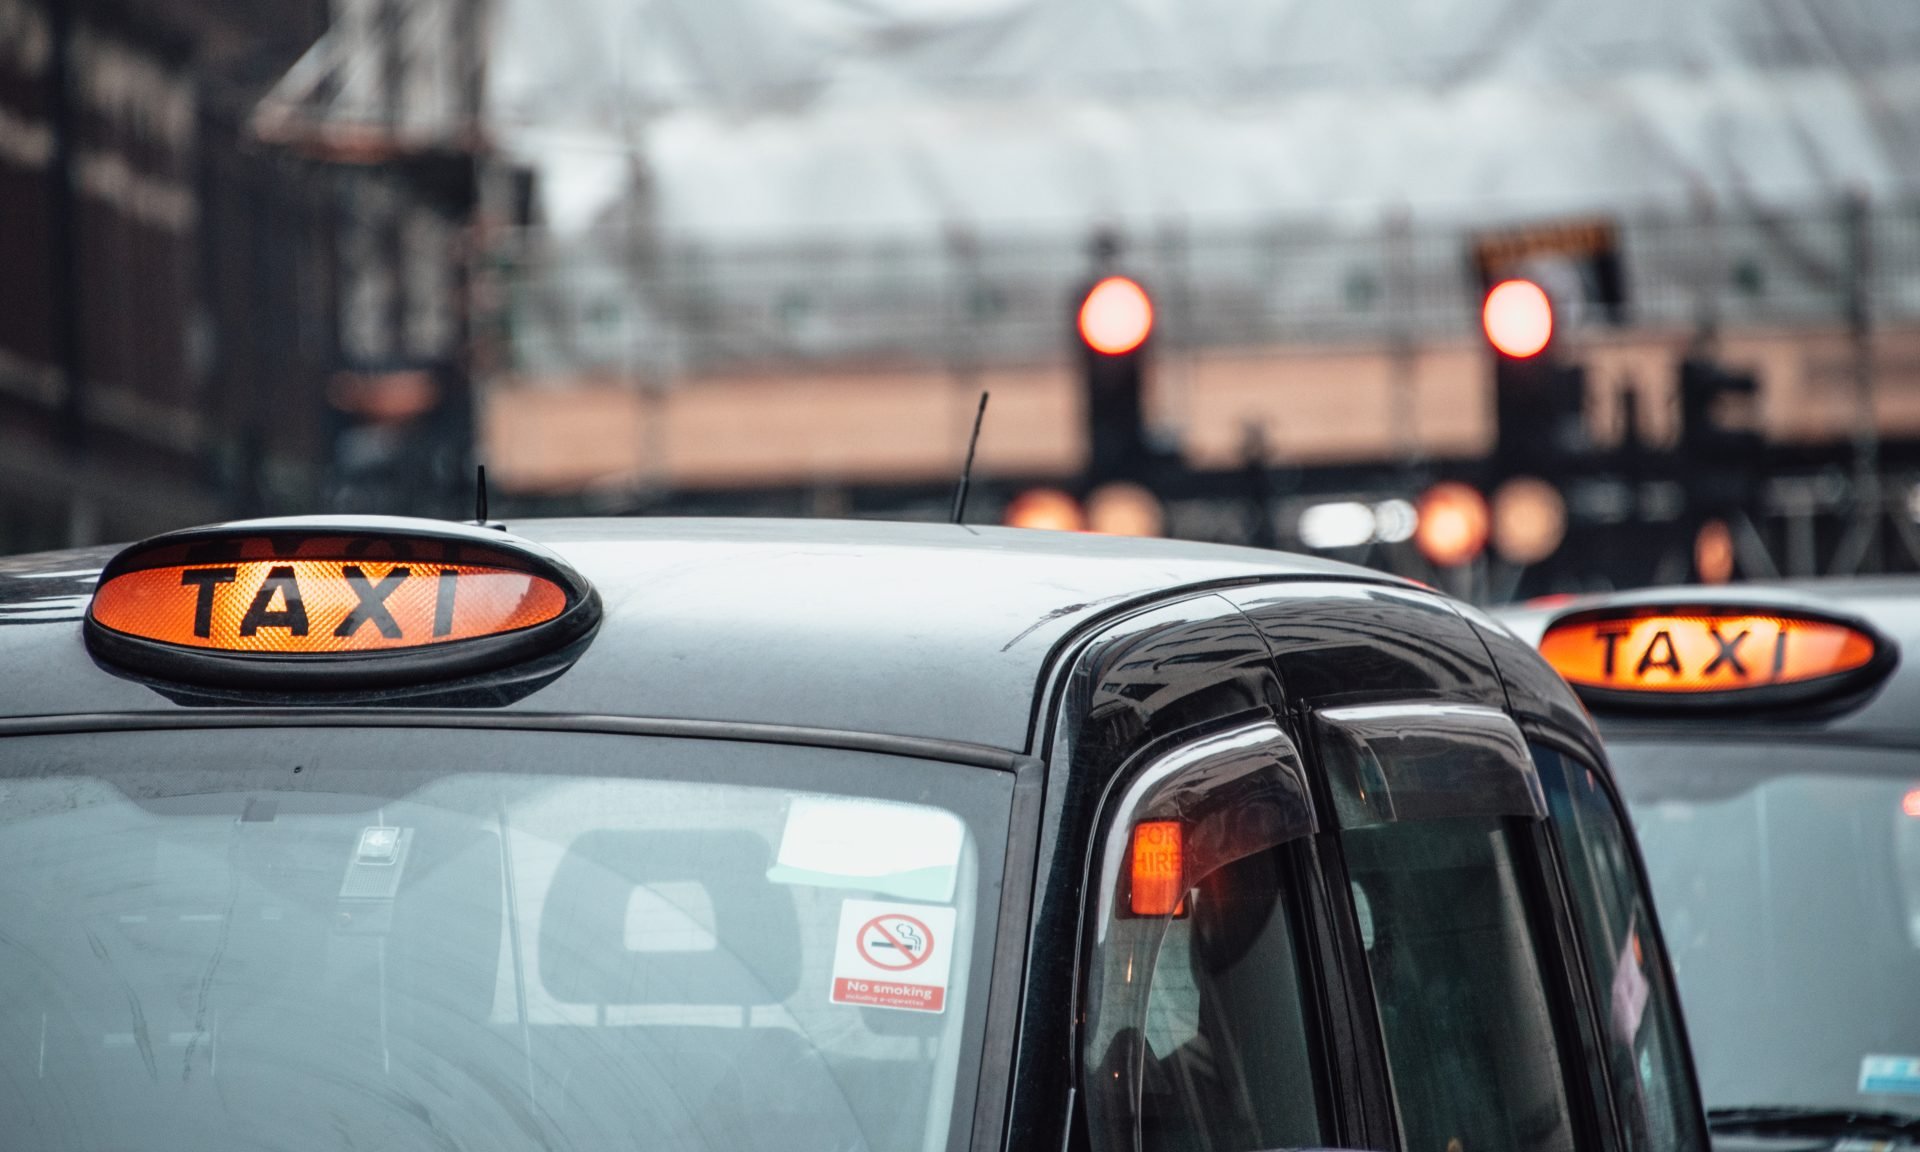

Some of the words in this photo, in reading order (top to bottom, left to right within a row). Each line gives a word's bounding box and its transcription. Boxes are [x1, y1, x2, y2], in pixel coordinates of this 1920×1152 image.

[181, 566, 458, 638] TAXI
[1597, 628, 1787, 681] TAXI
[1135, 826, 1181, 845] FOR
[1132, 852, 1182, 873] HIRE
[845, 994, 878, 1003] including
[847, 981, 869, 992] No
[873, 984, 933, 1001] smoking
